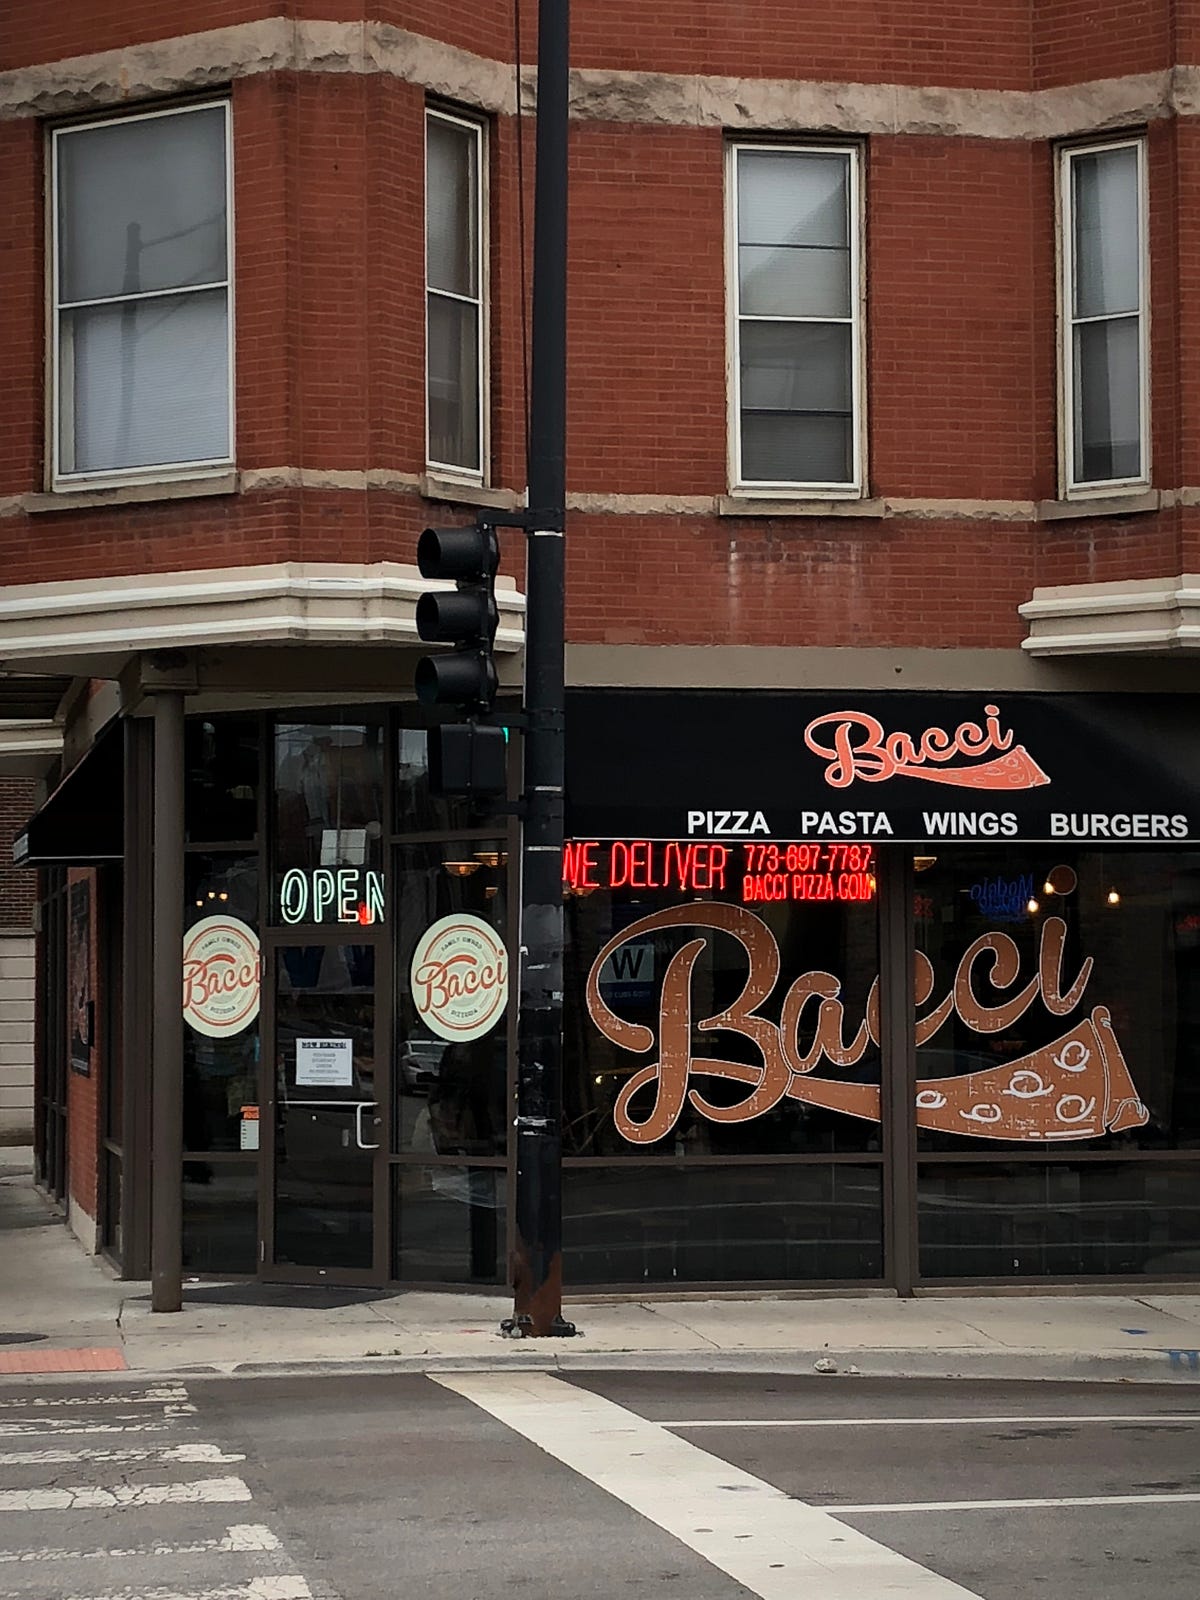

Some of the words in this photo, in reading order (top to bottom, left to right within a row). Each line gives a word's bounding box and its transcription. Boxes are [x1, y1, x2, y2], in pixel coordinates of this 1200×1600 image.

[804, 704, 1014, 788] Bacci
[687, 811, 771, 835] PIZZA
[801, 812, 894, 835] PASTA
[922, 812, 1018, 836] WINGS
[1050, 813, 1189, 838] BURGERS
[610, 842, 728, 891] DELIVER
[743, 844, 872, 872] 773-697-7787
[280, 868, 385, 924] OPEN
[415, 949, 508, 1014] Bacci
[610, 948, 645, 980] W
